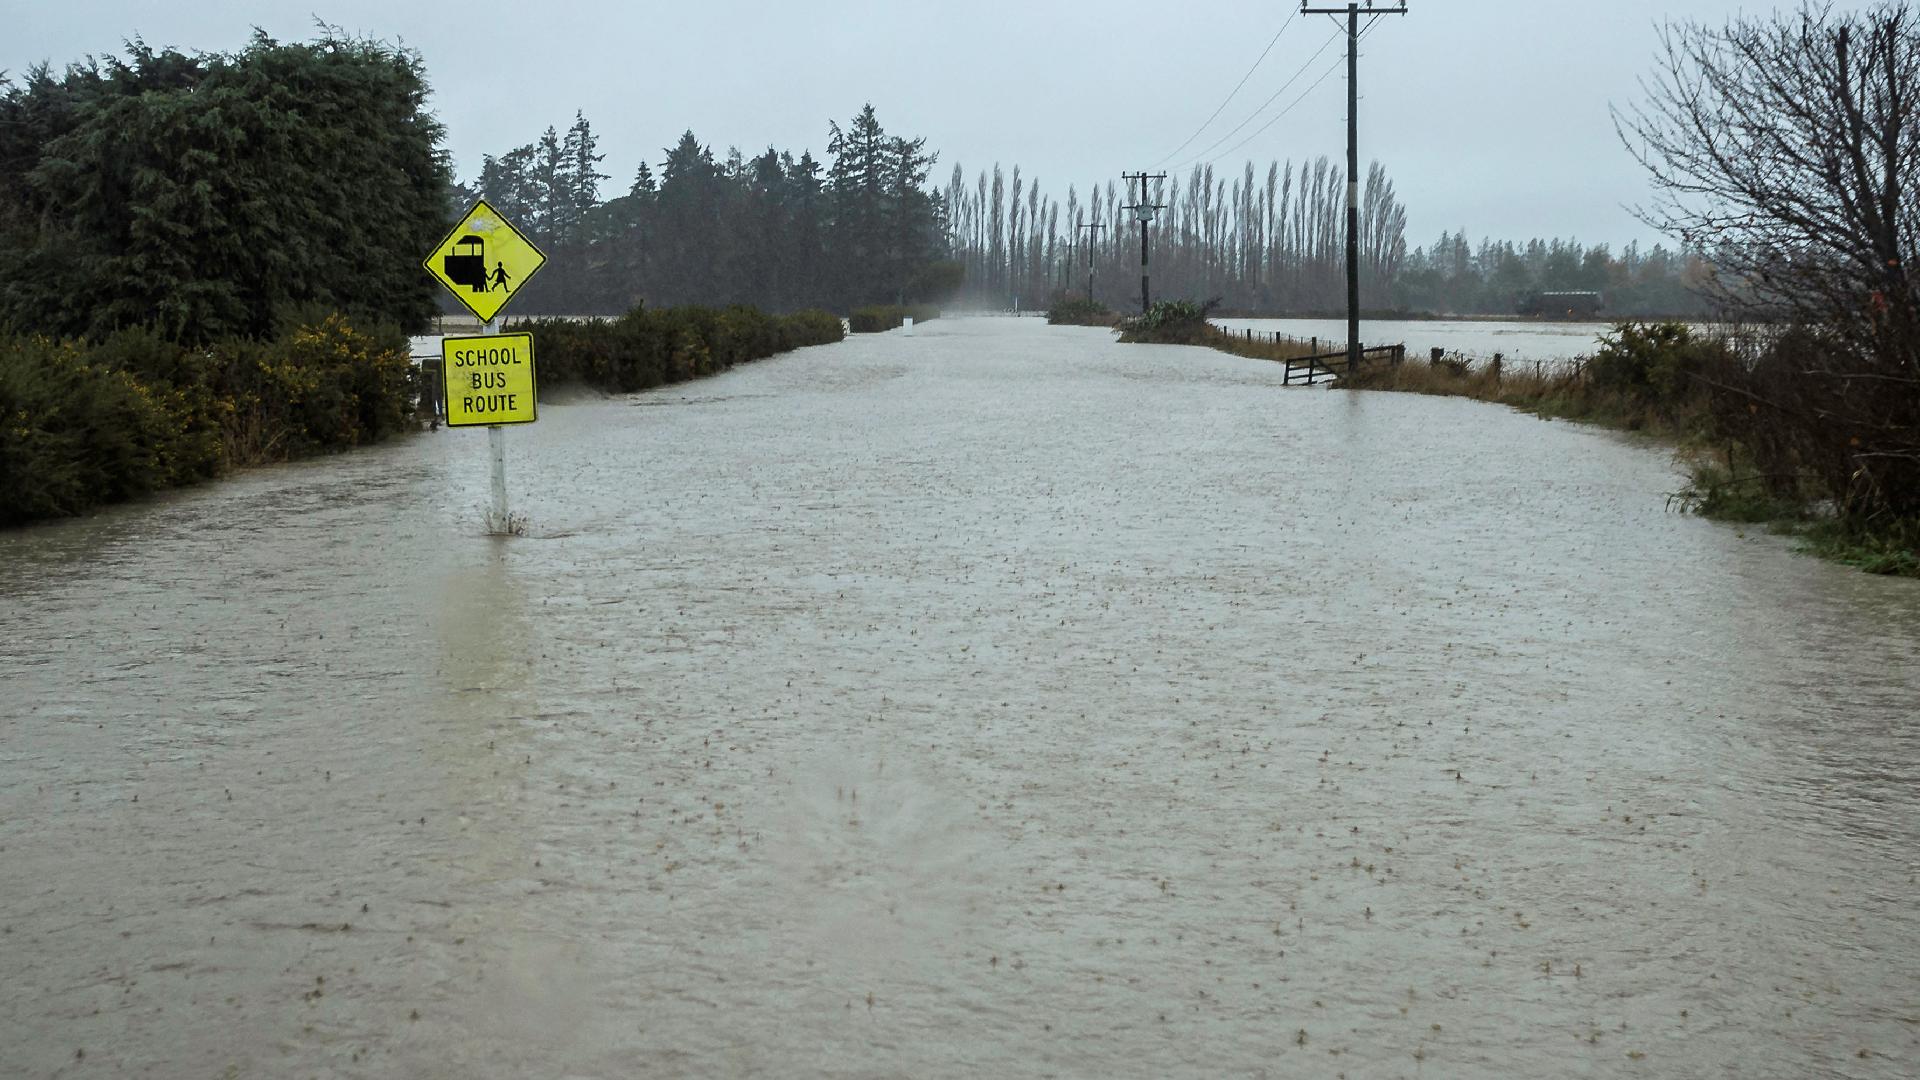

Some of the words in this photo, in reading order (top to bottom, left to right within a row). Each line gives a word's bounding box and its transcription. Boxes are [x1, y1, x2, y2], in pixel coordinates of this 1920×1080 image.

[455, 347, 521, 367] SCHOOL
[472, 372, 506, 389] BUS
[463, 394, 517, 413] ROUTE
